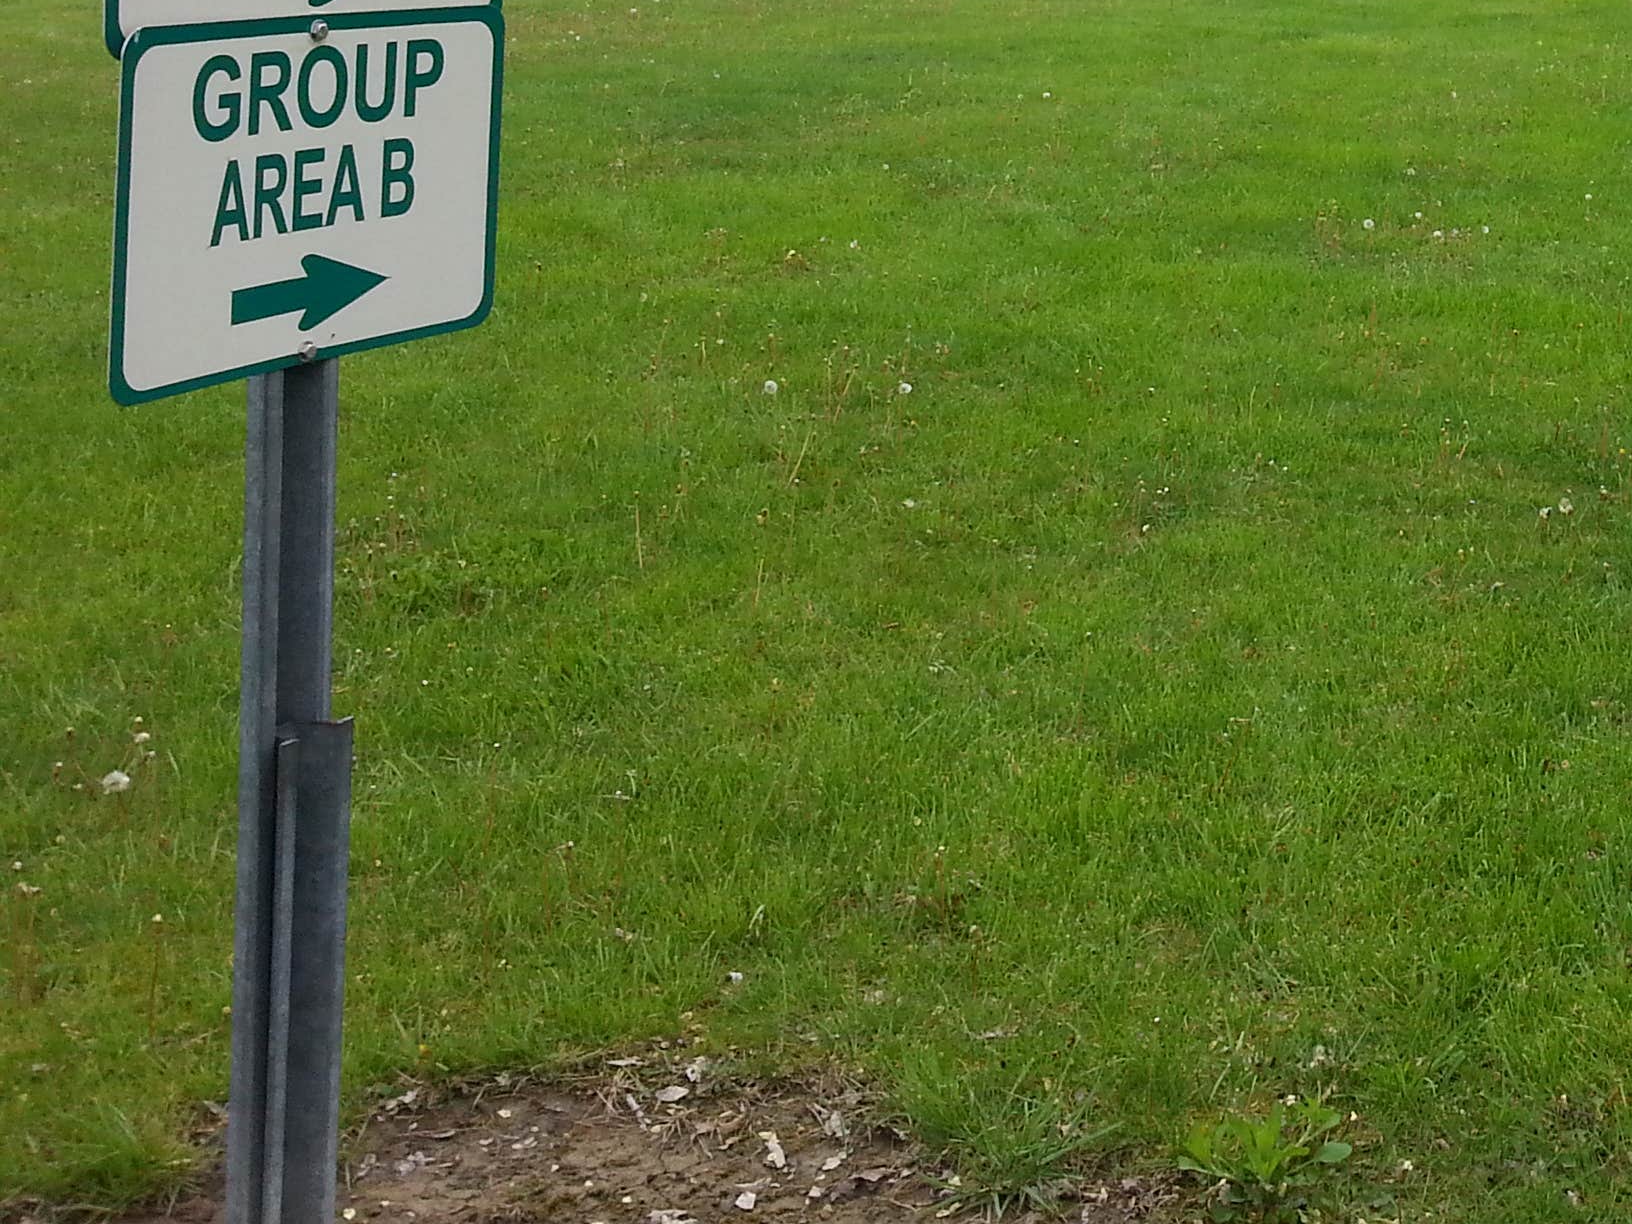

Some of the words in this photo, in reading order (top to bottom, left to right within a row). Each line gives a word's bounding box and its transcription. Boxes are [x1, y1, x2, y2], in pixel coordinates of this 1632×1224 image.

[192, 38, 445, 143] GROUP
[209, 143, 365, 248] AREA
[380, 137, 416, 219] B
